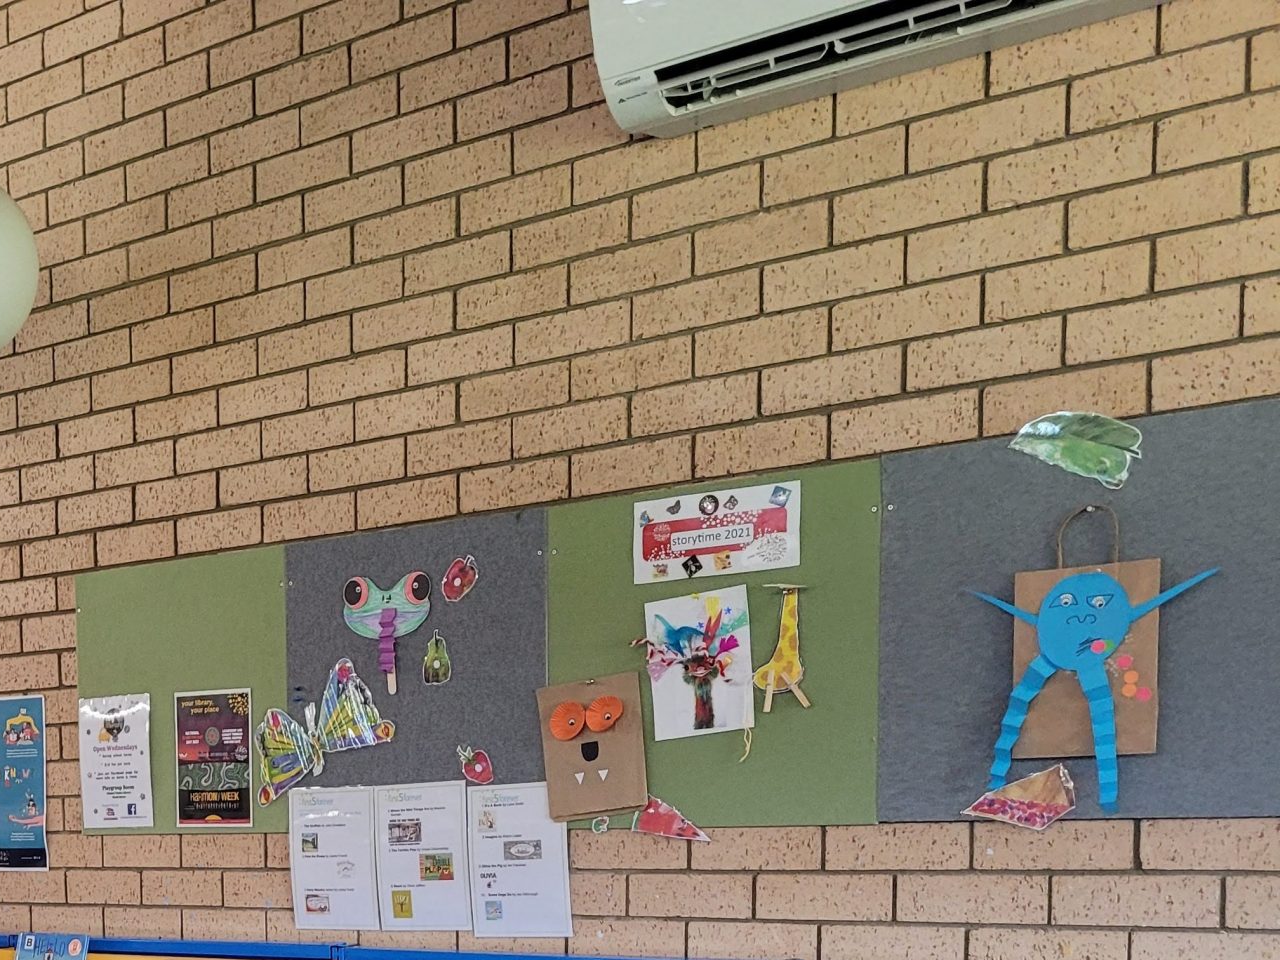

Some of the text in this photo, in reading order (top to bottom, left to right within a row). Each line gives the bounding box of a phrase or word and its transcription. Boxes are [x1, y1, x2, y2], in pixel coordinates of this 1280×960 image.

[672, 527, 751, 547] storytime 2021
[191, 708, 203, 716] your
[221, 791, 240, 801] WEEK
[27, 938, 33, 947] B
[32, 941, 65, 957] HELLO
